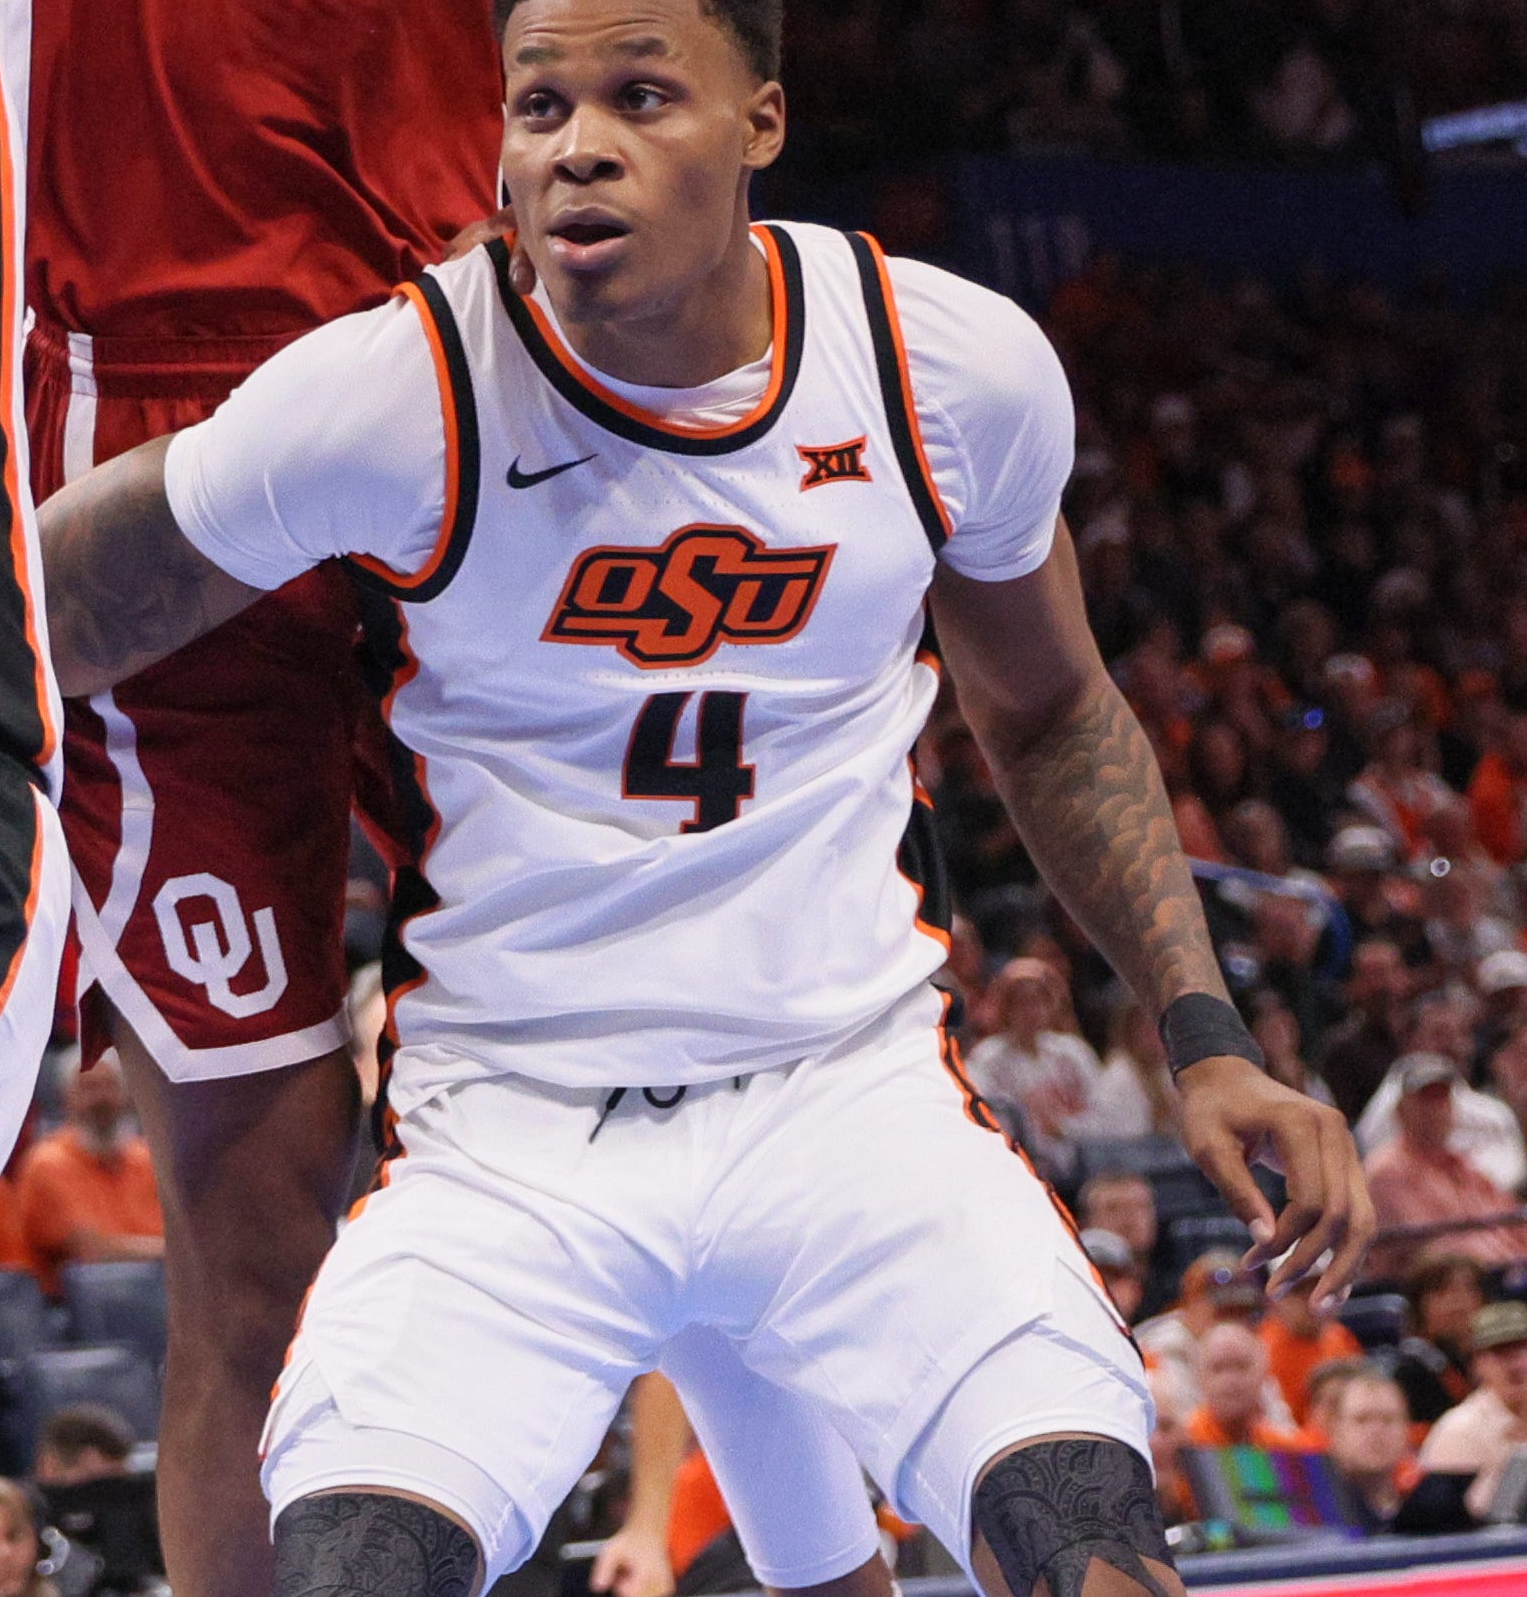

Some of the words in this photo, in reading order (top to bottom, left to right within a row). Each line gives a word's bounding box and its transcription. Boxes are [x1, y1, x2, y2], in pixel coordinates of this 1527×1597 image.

[799, 440, 869, 488] XII
[539, 521, 839, 670] OSU
[621, 689, 756, 834] 4
[152, 871, 289, 1020] OU
